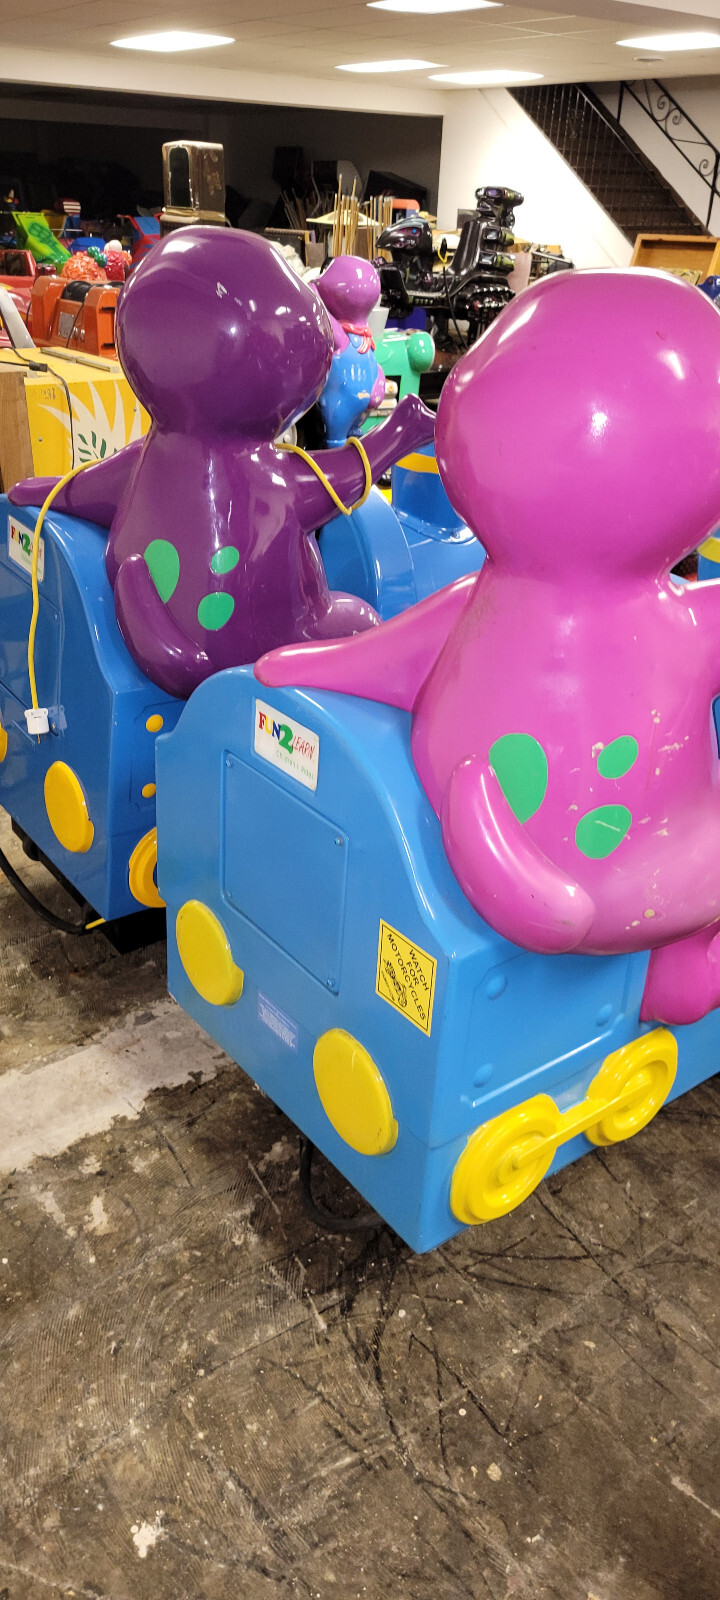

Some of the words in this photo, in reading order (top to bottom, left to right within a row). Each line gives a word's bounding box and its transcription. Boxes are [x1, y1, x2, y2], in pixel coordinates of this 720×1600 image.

[387, 933, 426, 1020] MOTORCYCLES
[406, 961, 420, 986] FOR
[409, 949, 430, 991] WATCH
